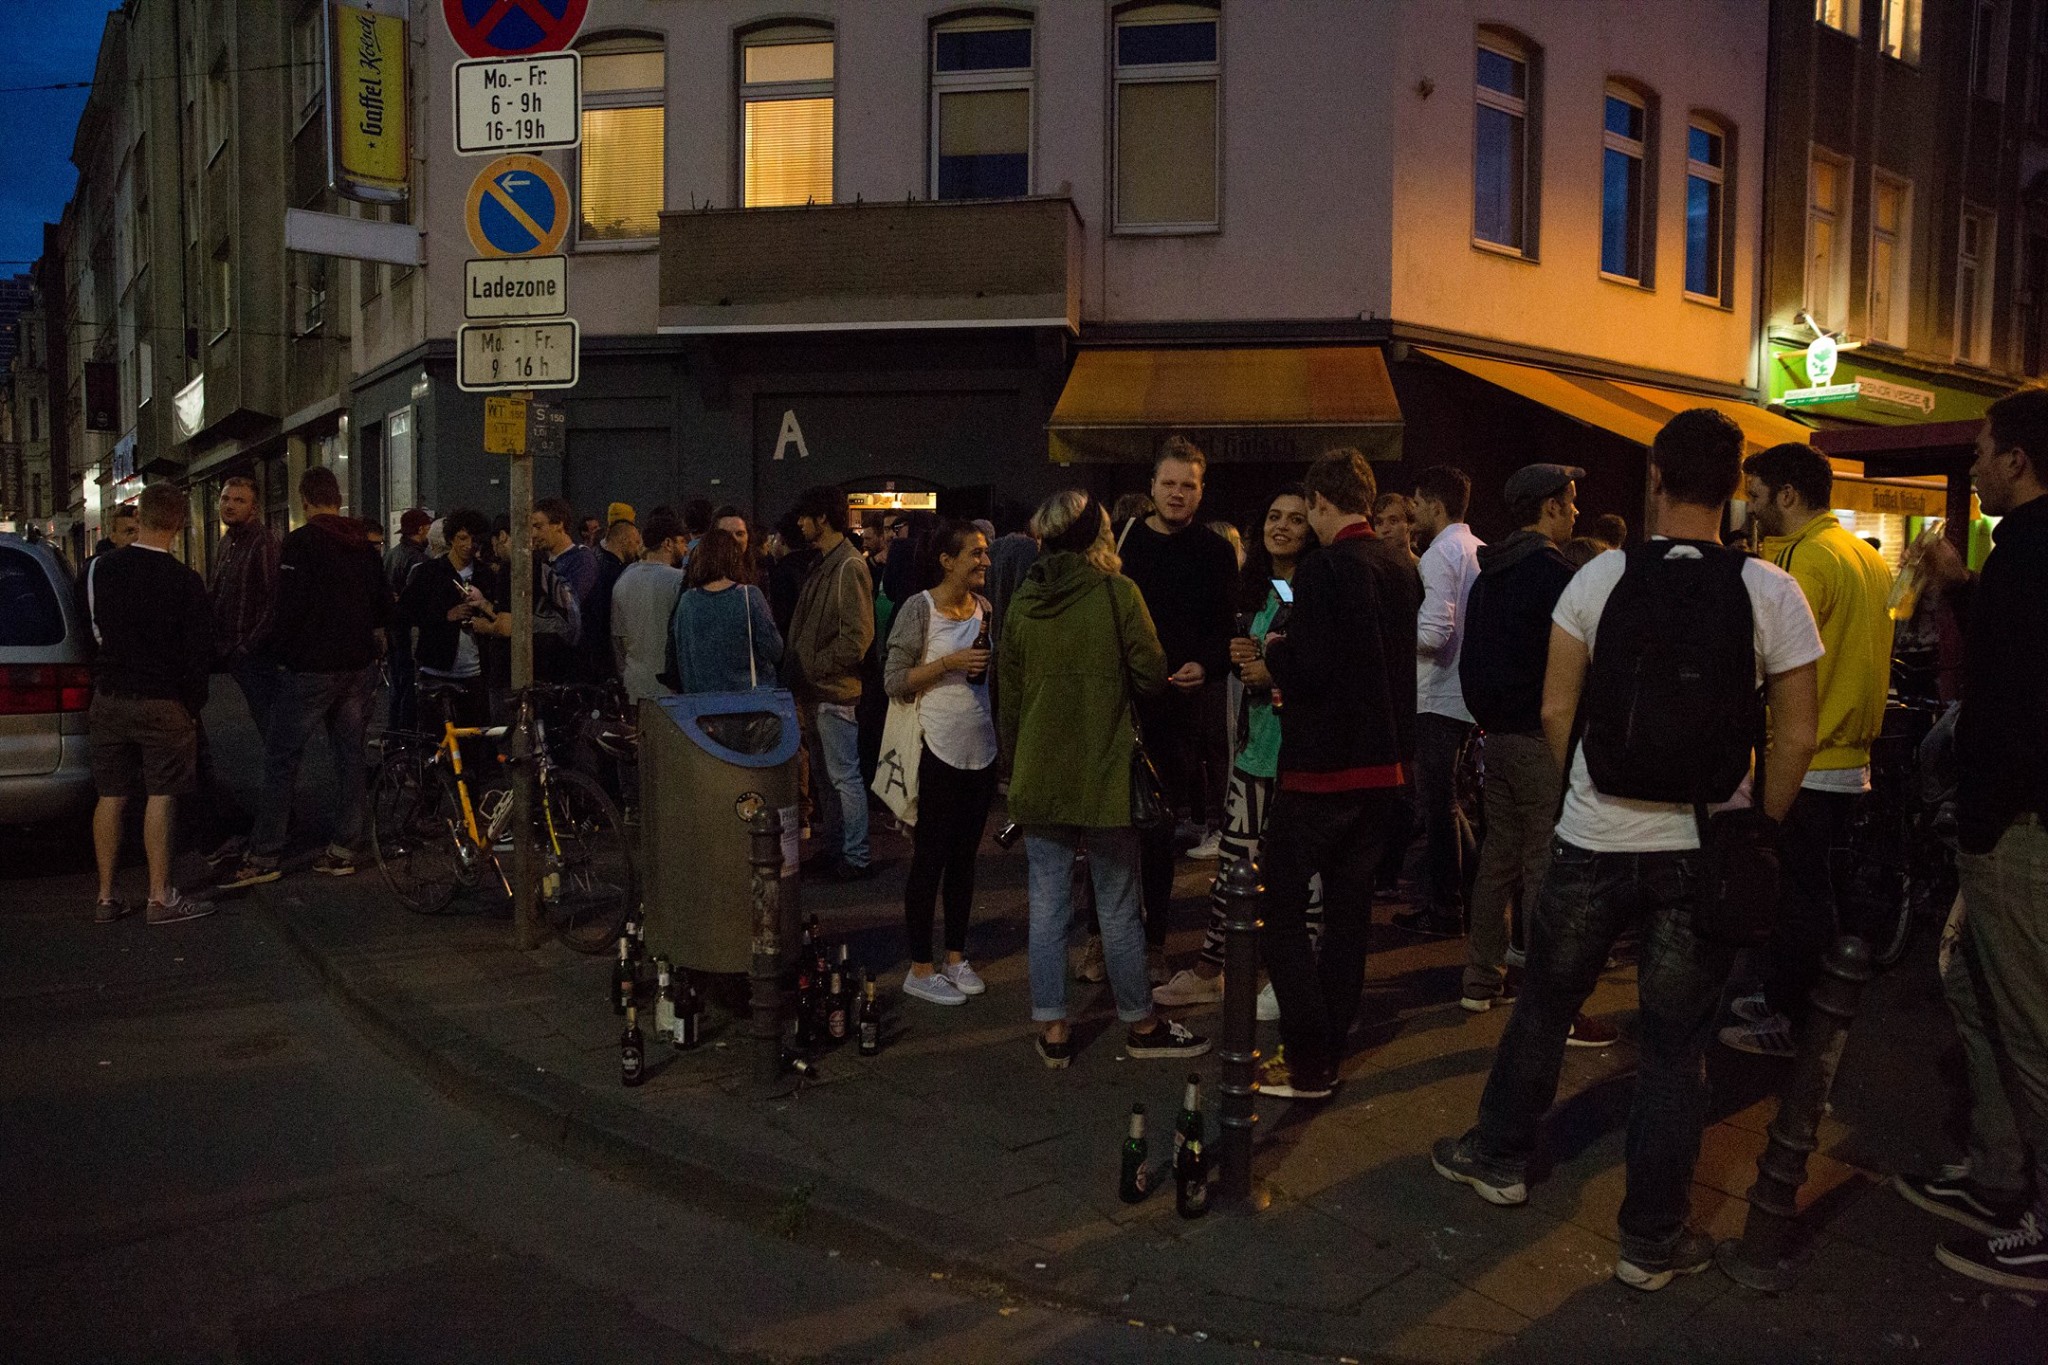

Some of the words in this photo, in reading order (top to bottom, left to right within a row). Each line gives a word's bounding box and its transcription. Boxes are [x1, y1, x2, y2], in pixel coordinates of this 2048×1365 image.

[529, 65, 547, 86] Fr.
[359, 78, 384, 137] Gaffel
[472, 275, 556, 299] Ladezone
[535, 408, 546, 421] S
[550, 413, 565, 423] 150
[773, 409, 809, 460] A
